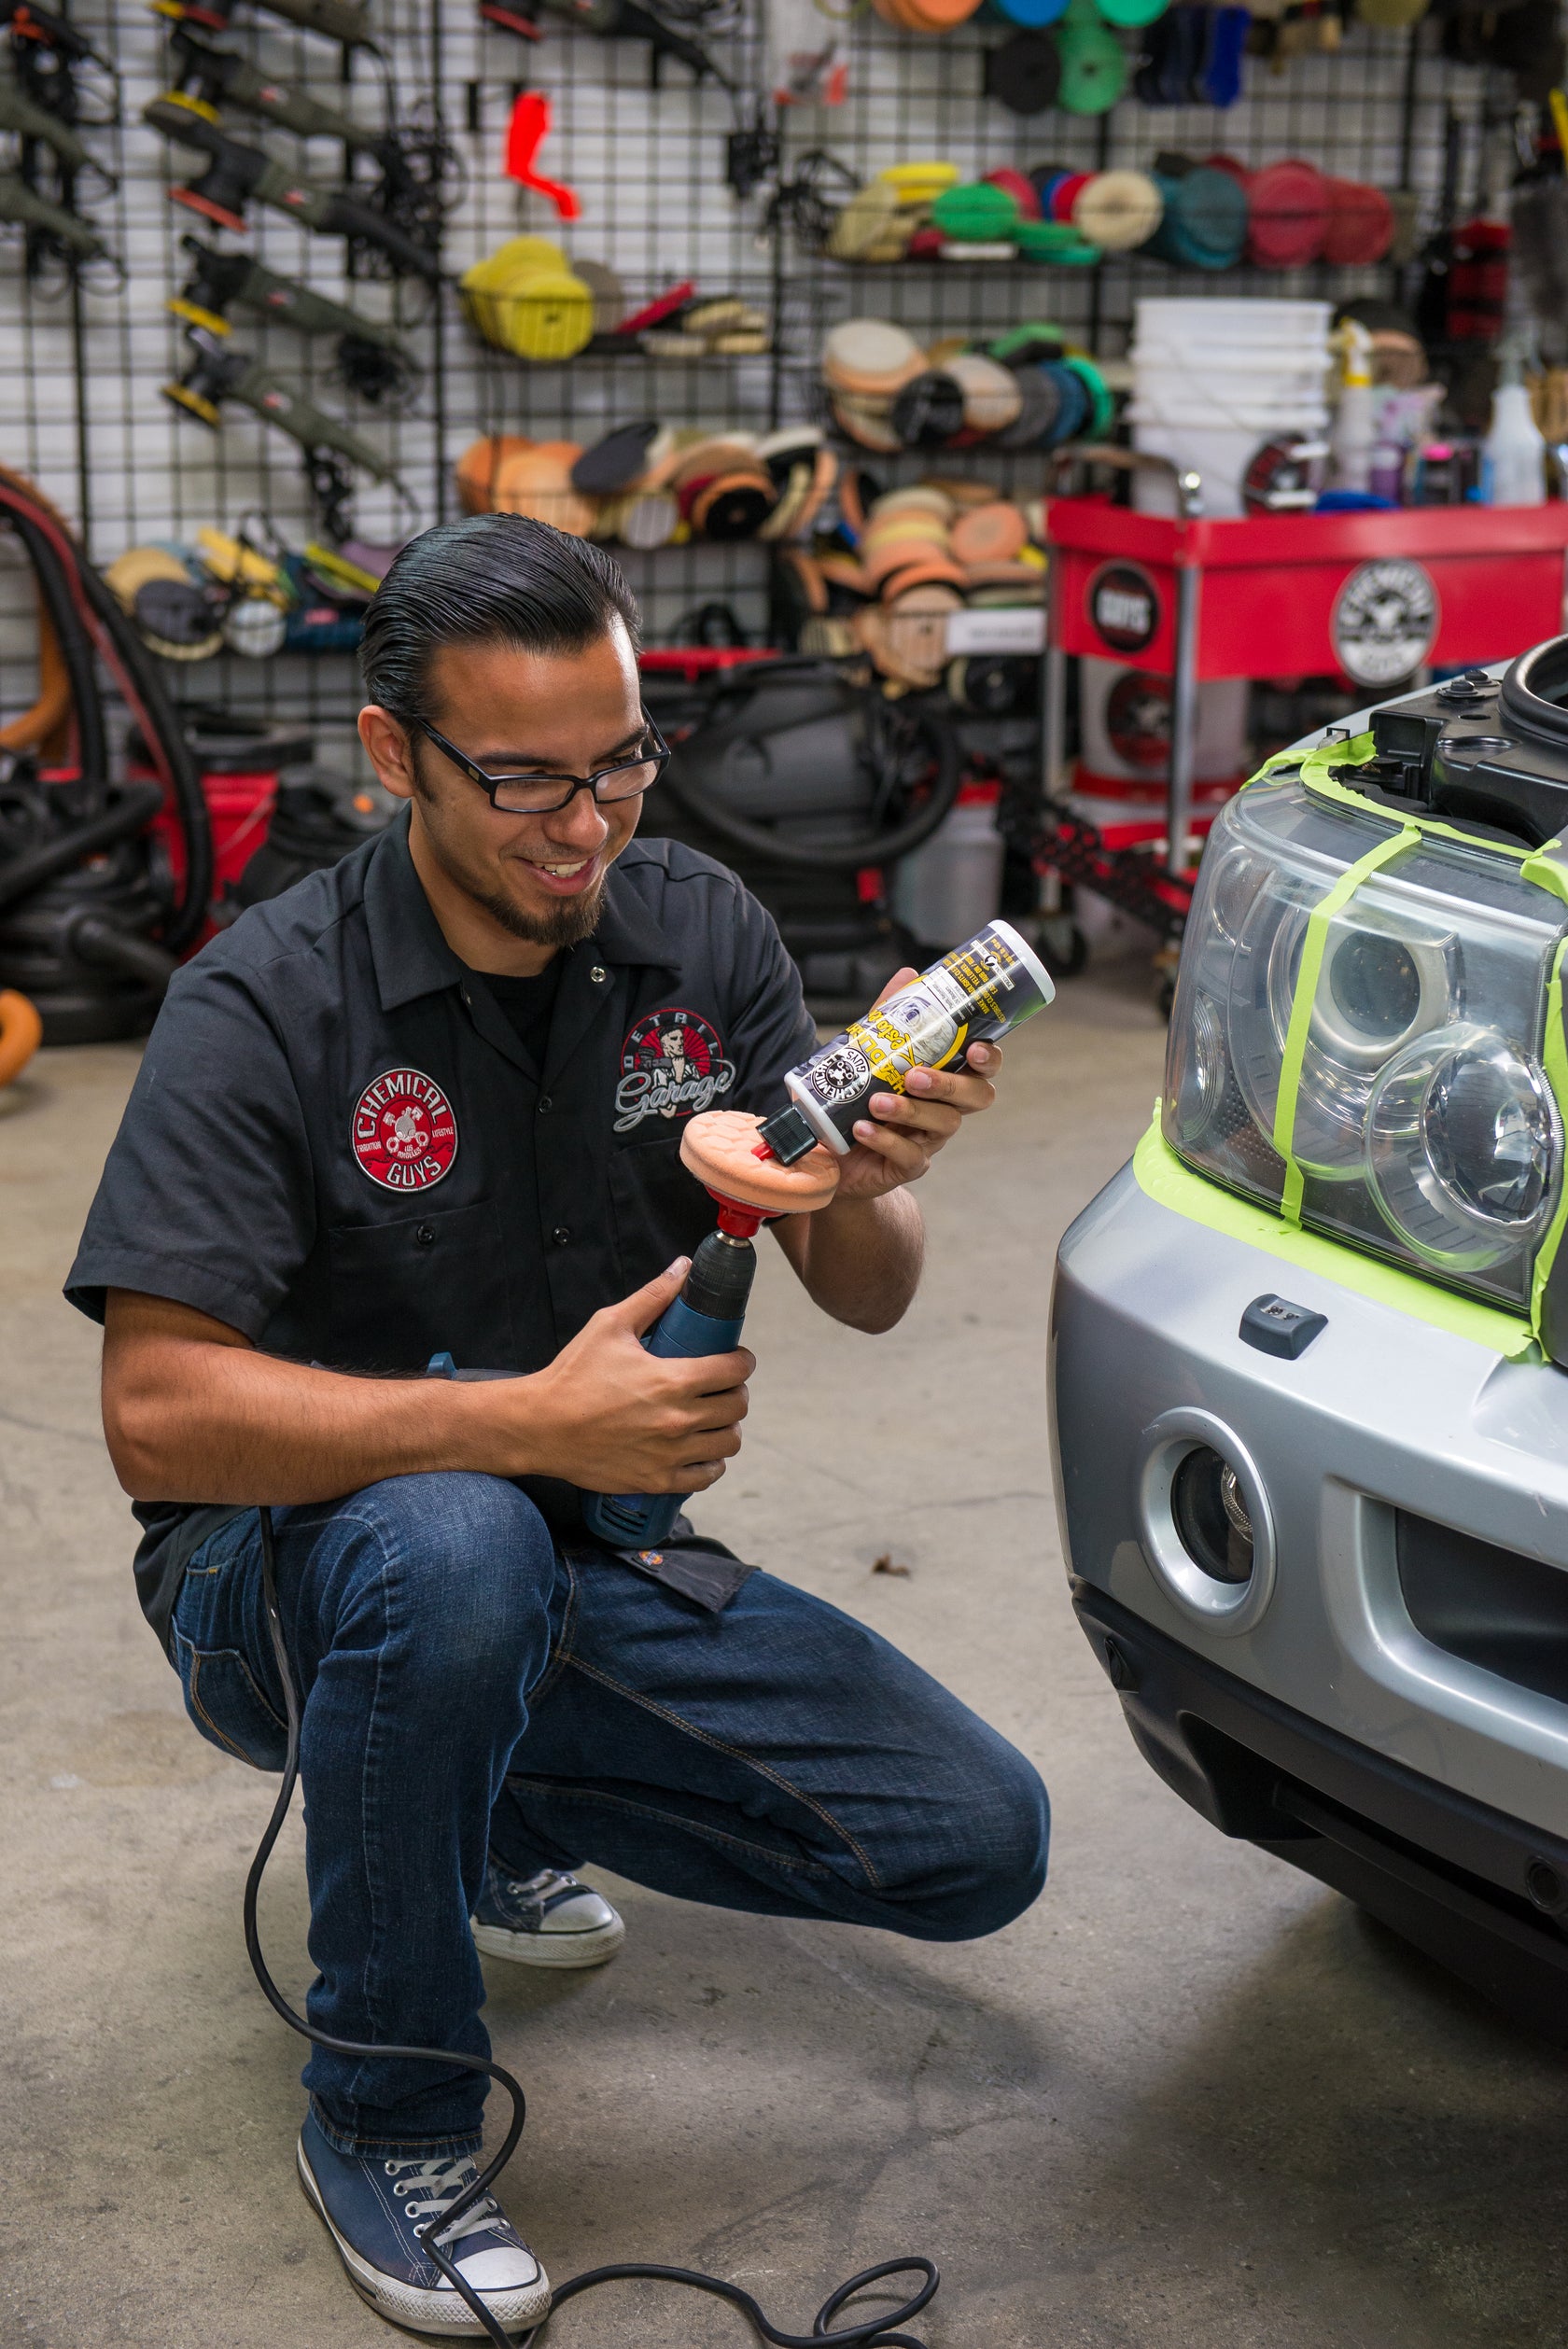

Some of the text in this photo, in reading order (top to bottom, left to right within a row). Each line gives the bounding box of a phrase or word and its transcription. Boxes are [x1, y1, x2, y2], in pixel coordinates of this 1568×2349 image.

[623, 1012, 718, 1069] DETAIL
[845, 1051, 867, 1073] GUYS
[357, 1073, 448, 1139] CHEMICAL
[613, 1069, 734, 1132] Garage
[386, 1155, 441, 1187] GUYS
